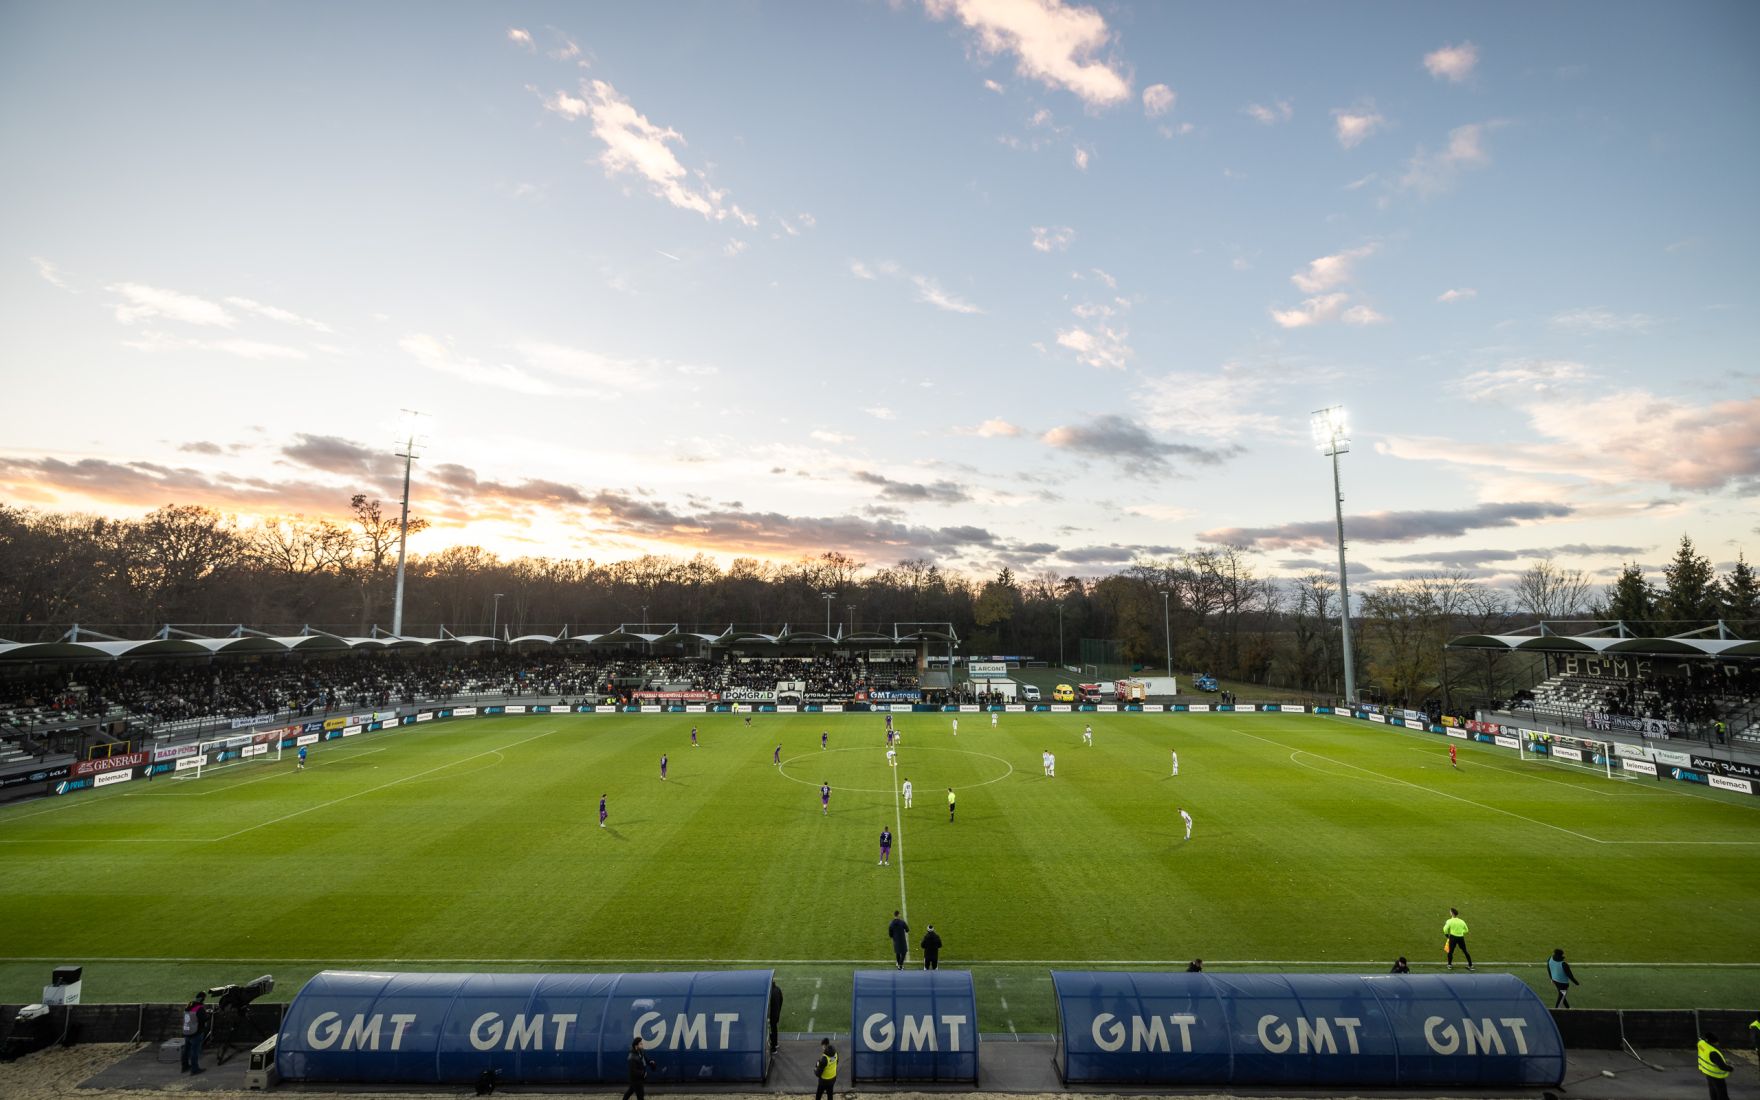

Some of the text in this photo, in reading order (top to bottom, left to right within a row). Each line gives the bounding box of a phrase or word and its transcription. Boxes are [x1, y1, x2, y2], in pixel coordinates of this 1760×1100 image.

[94, 754, 142, 770] GENERALI
[98, 772, 129, 783] telemach
[1626, 762, 1656, 772] telemach
[1712, 778, 1747, 790] telemach
[308, 1012, 416, 1050] GMT
[470, 1012, 577, 1050] GMT
[634, 1012, 739, 1050] GMT
[863, 1013, 967, 1051] GMT
[1092, 1013, 1196, 1052] GMT
[1258, 1014, 1361, 1055] GMT
[1424, 1015, 1528, 1056] GMT
